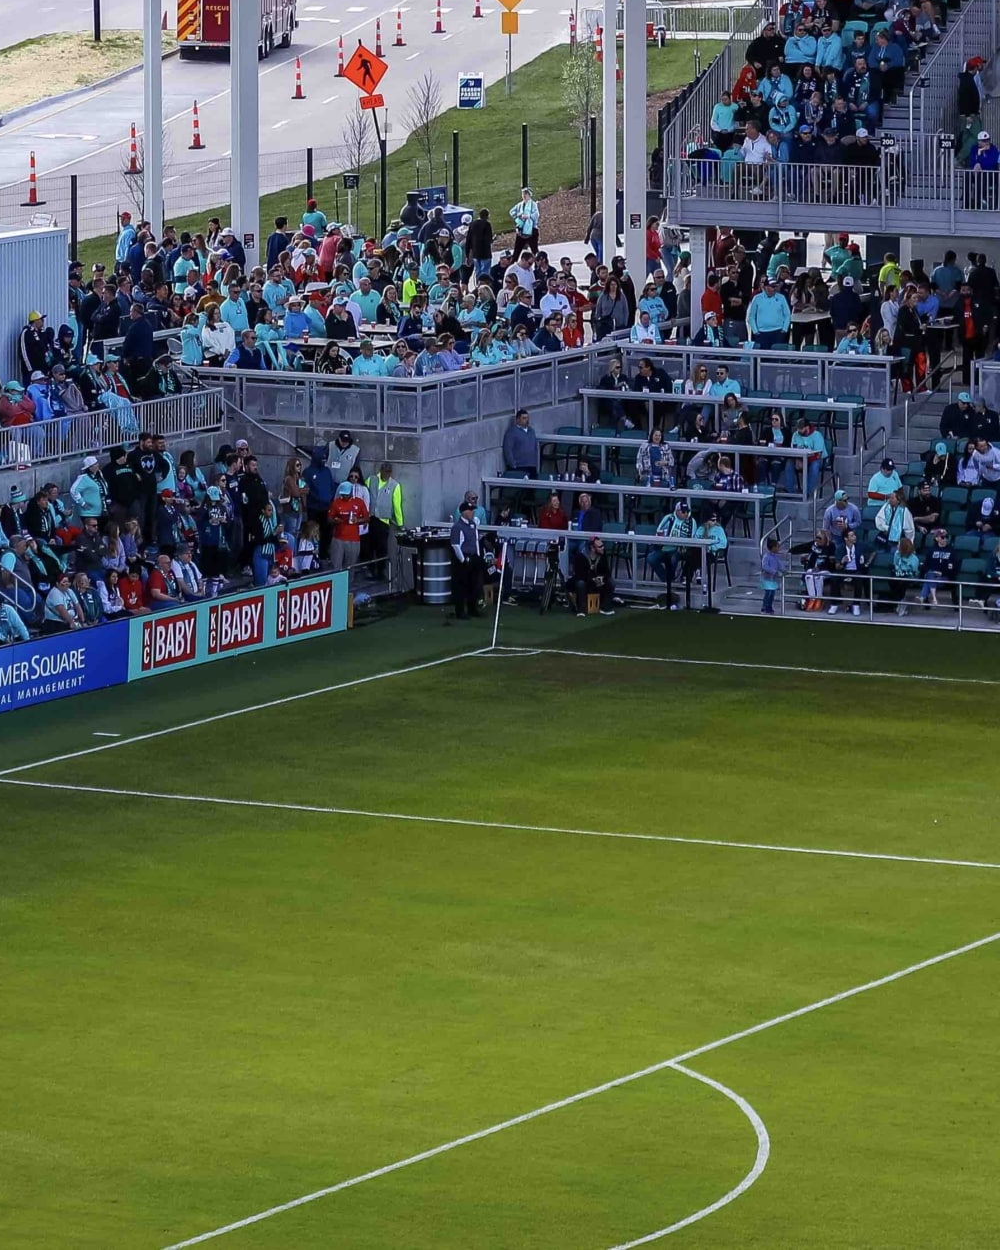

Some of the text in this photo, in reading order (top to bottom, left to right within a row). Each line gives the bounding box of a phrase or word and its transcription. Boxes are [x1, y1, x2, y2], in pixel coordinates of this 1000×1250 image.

[214, 12, 222, 25] 1
[221, 602, 262, 646] BABY
[290, 587, 331, 630] BABY
[155, 617, 195, 663] BABY
[31, 647, 86, 680] SQUARE
[17, 676, 84, 701] MANAGEMENT
